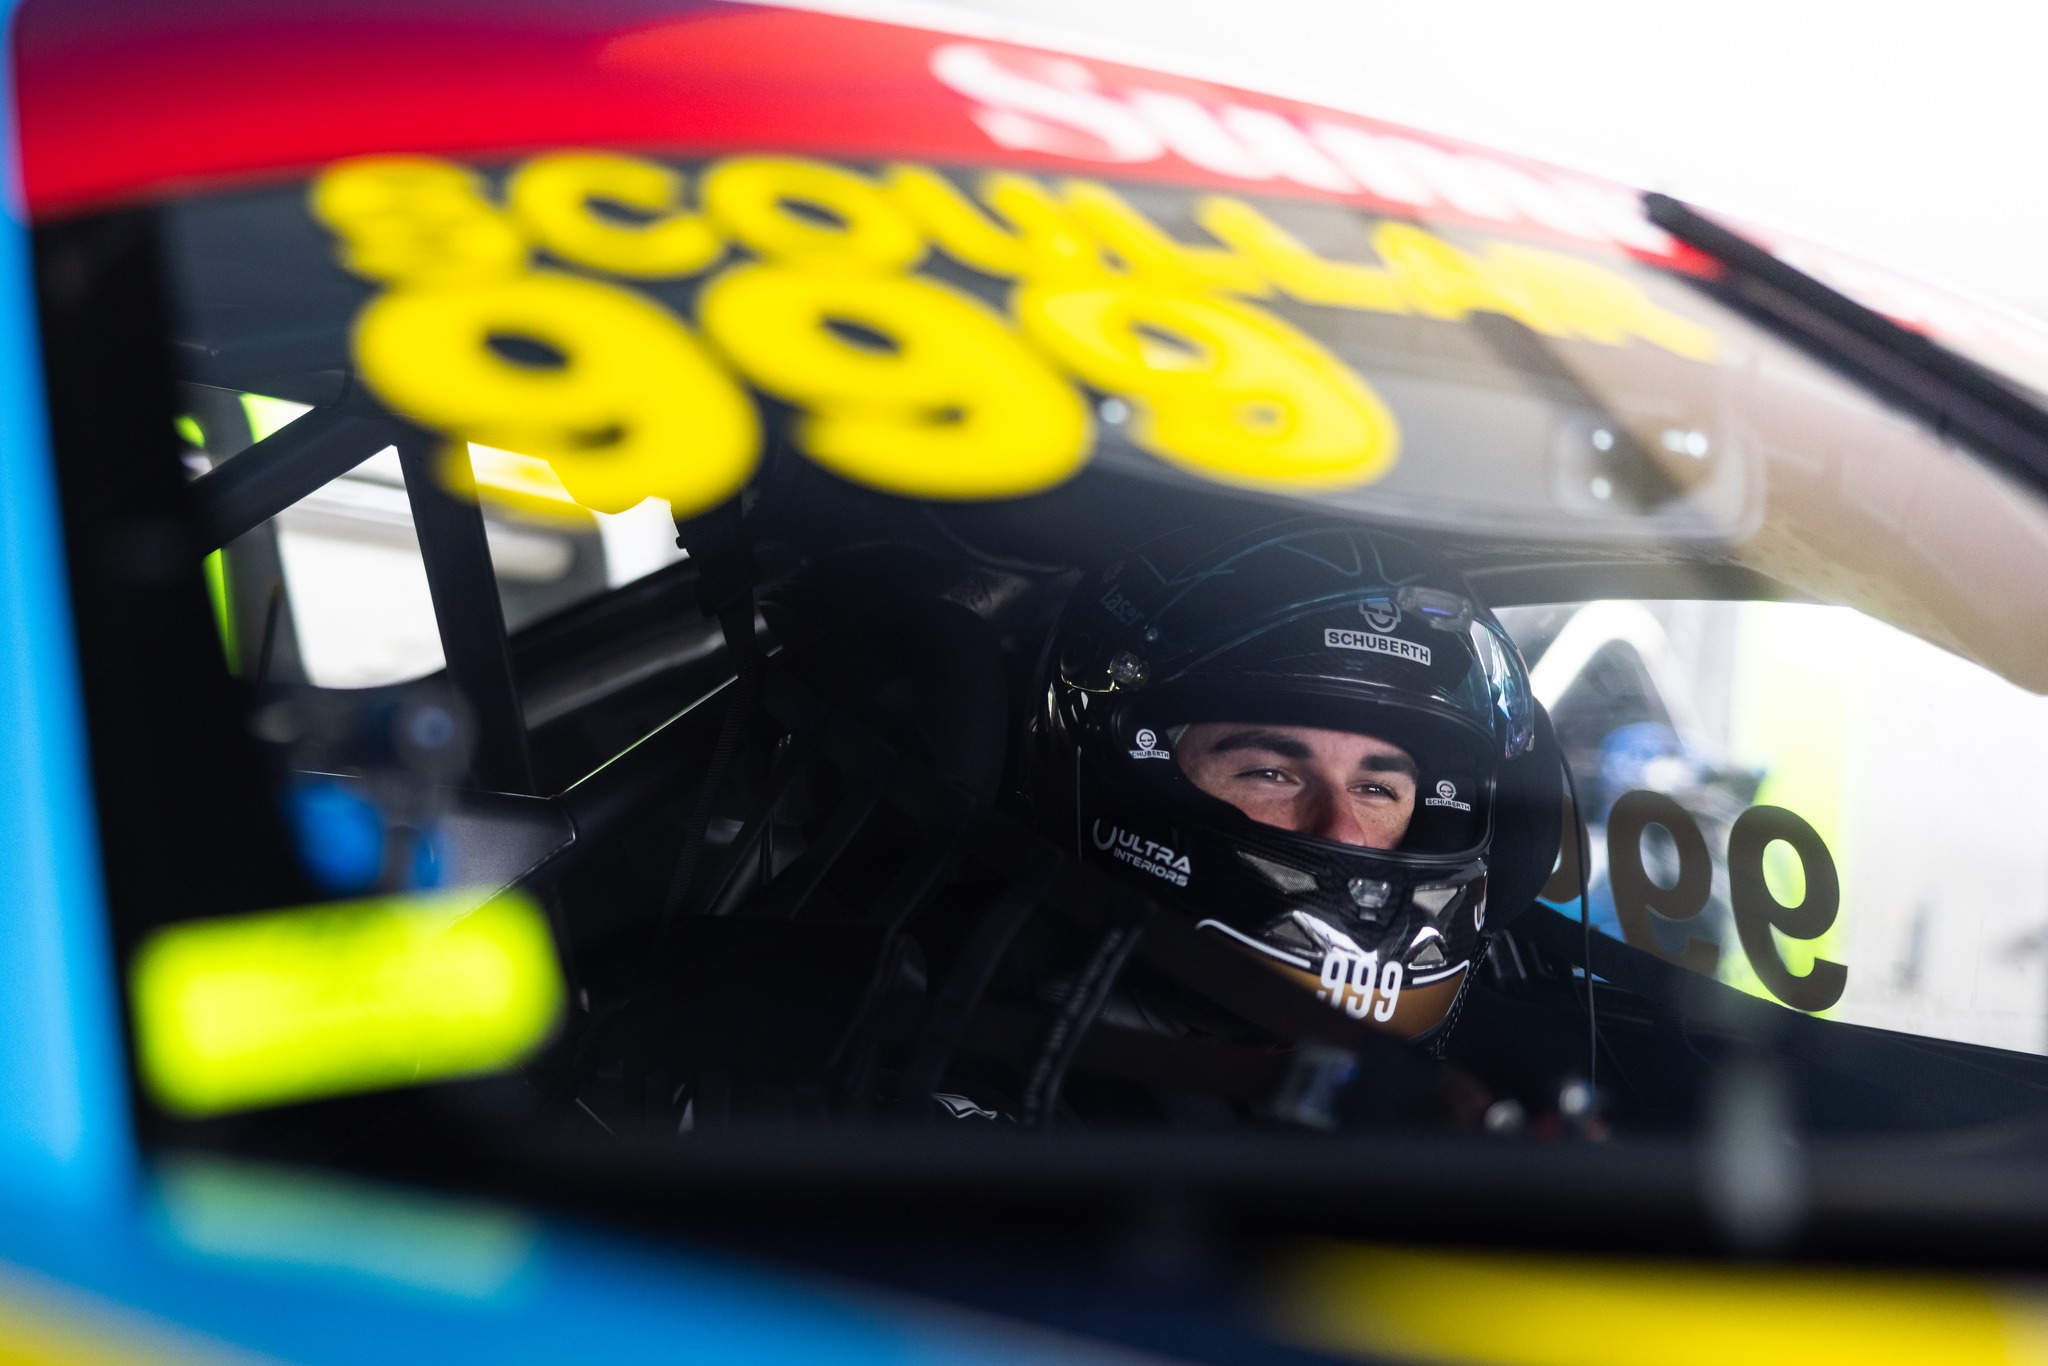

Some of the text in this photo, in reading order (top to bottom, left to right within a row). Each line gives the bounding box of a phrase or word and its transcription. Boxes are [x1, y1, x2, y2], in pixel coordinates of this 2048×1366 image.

[353, 266, 1401, 524] 999
[1327, 630, 1430, 663] SCHUBERTH
[1129, 750, 1170, 760] CHUBERTH
[1426, 798, 1470, 811] SCHUBERTH
[1112, 847, 1189, 888] INTERIORS
[1118, 828, 1192, 875] ULTRA
[1316, 949, 1404, 1023] 999
